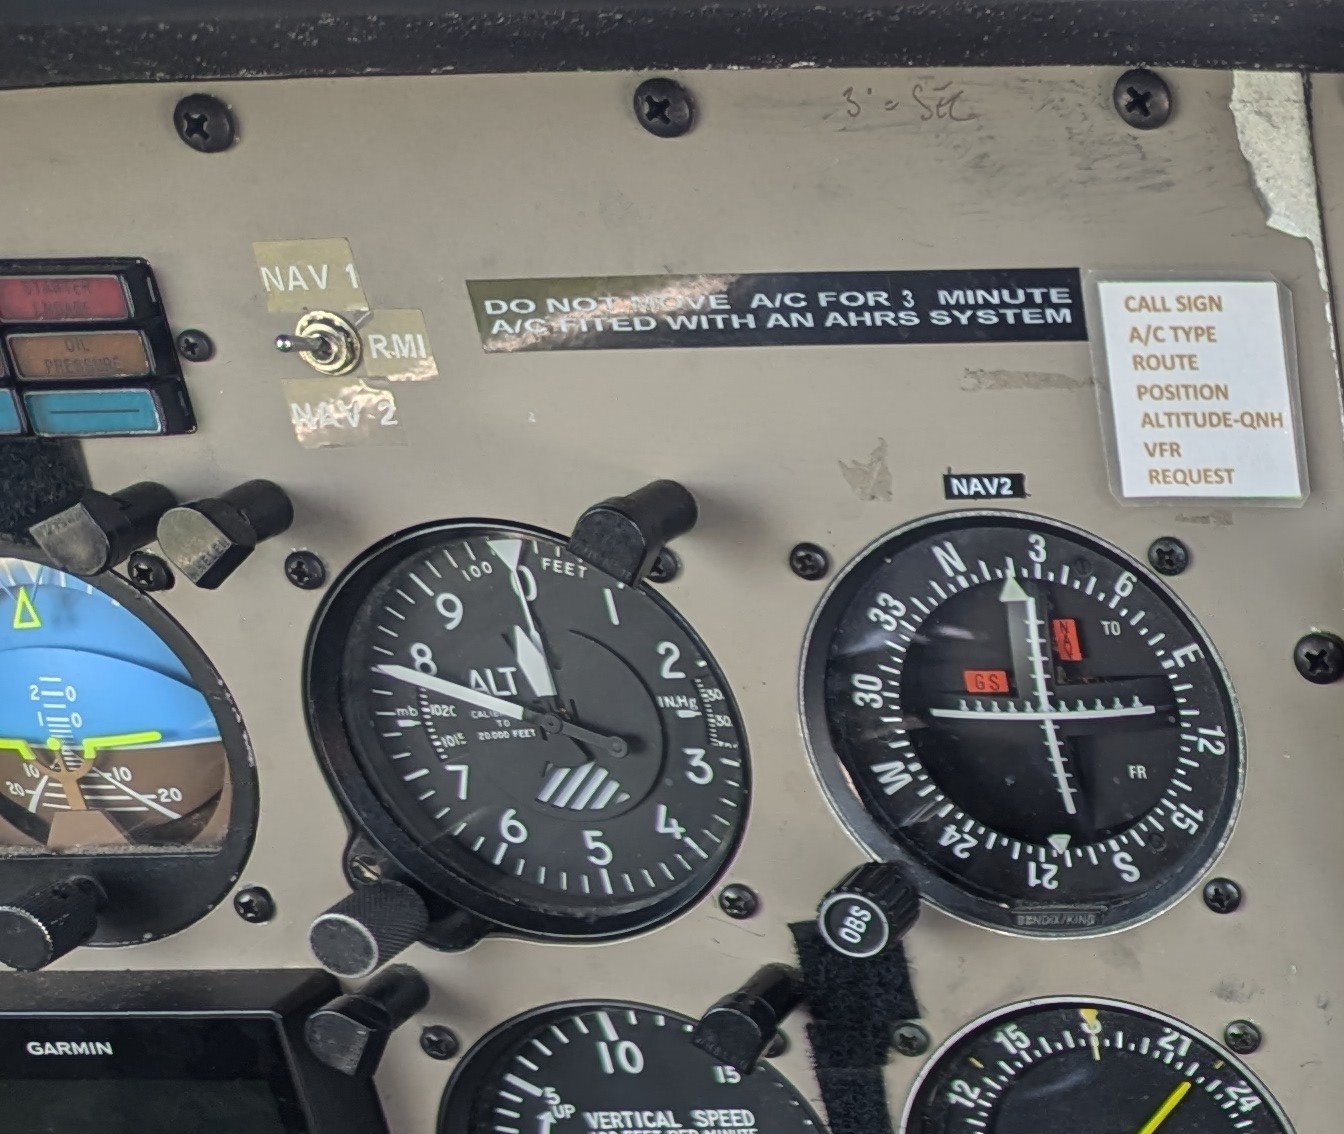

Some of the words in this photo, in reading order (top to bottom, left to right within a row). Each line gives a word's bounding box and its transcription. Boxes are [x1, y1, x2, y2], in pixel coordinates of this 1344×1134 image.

[260, 265, 328, 292] NAV
[344, 263, 360, 290] 1
[484, 299, 536, 314] DO
[546, 297, 619, 313] NOT
[632, 294, 731, 311] MOVE
[751, 293, 807, 309] A/C
[818, 292, 890, 307] FOR
[902, 290, 915, 308] 3
[937, 288, 1072, 305] MINUTE
[1124, 296, 1173, 312] CALL
[1177, 296, 1223, 312] SIGN
[491, 317, 548, 335] A/C
[559, 315, 656, 333] FITED
[666, 314, 756, 330] WITH
[767, 312, 814, 328] AN
[825, 311, 920, 328] AHRS
[930, 308, 1072, 325] SYSTEM
[1129, 326, 1166, 346] A/C
[1169, 327, 1217, 343] TYPE
[369, 334, 426, 360] RMI
[1132, 355, 1199, 371] ROUTE
[1137, 385, 1229, 400] POSITION
[1141, 412, 1283, 431] ALTITUDE-QNH
[1144, 442, 1182, 458] VFR
[951, 477, 1013, 497] NAV2
[1148, 469, 1235, 488] REQUEST
[467, 665, 519, 697] ALT
[839, 904, 872, 943] OBS
[26, 1040, 114, 1056] GARMIN
[583, 1110, 682, 1129] VERTICAL
[694, 1109, 755, 1128] SPEED
